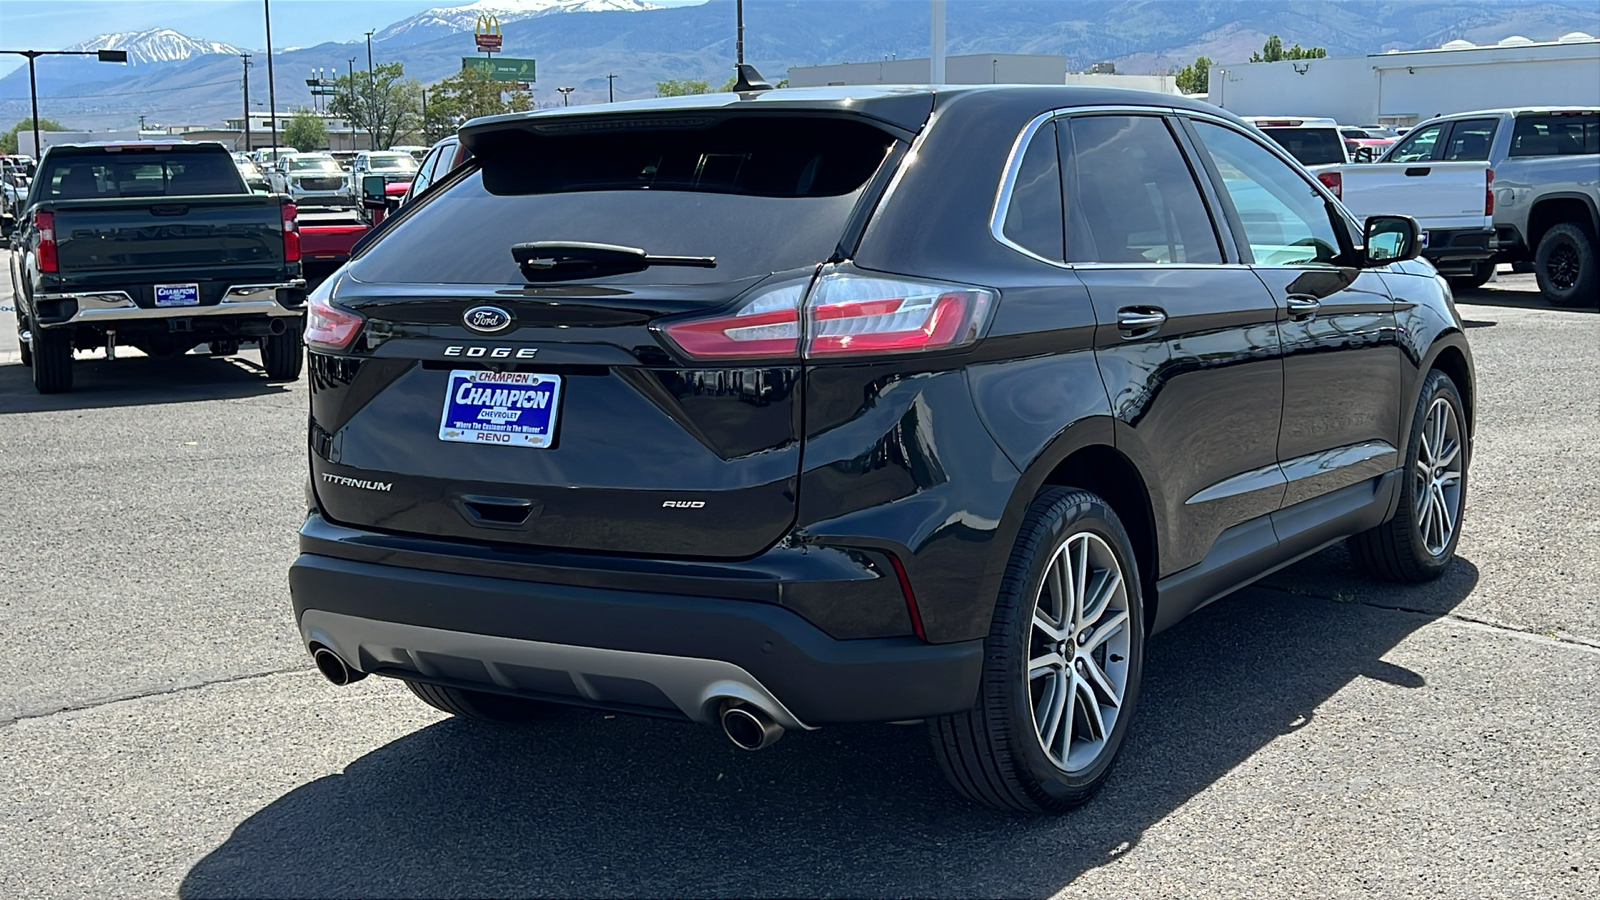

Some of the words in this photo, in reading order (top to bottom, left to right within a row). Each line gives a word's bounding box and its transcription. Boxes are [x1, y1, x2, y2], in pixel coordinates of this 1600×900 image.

[473, 311, 499, 325] Ford
[444, 346, 538, 358] EDGE
[479, 372, 529, 383] CHAMPION
[455, 382, 550, 409] CHAMPION
[480, 410, 518, 419] CHEVROLET
[482, 423, 506, 431] Customer
[512, 424, 521, 432] The
[476, 432, 511, 442] RENO
[321, 472, 393, 492] TITANIUM
